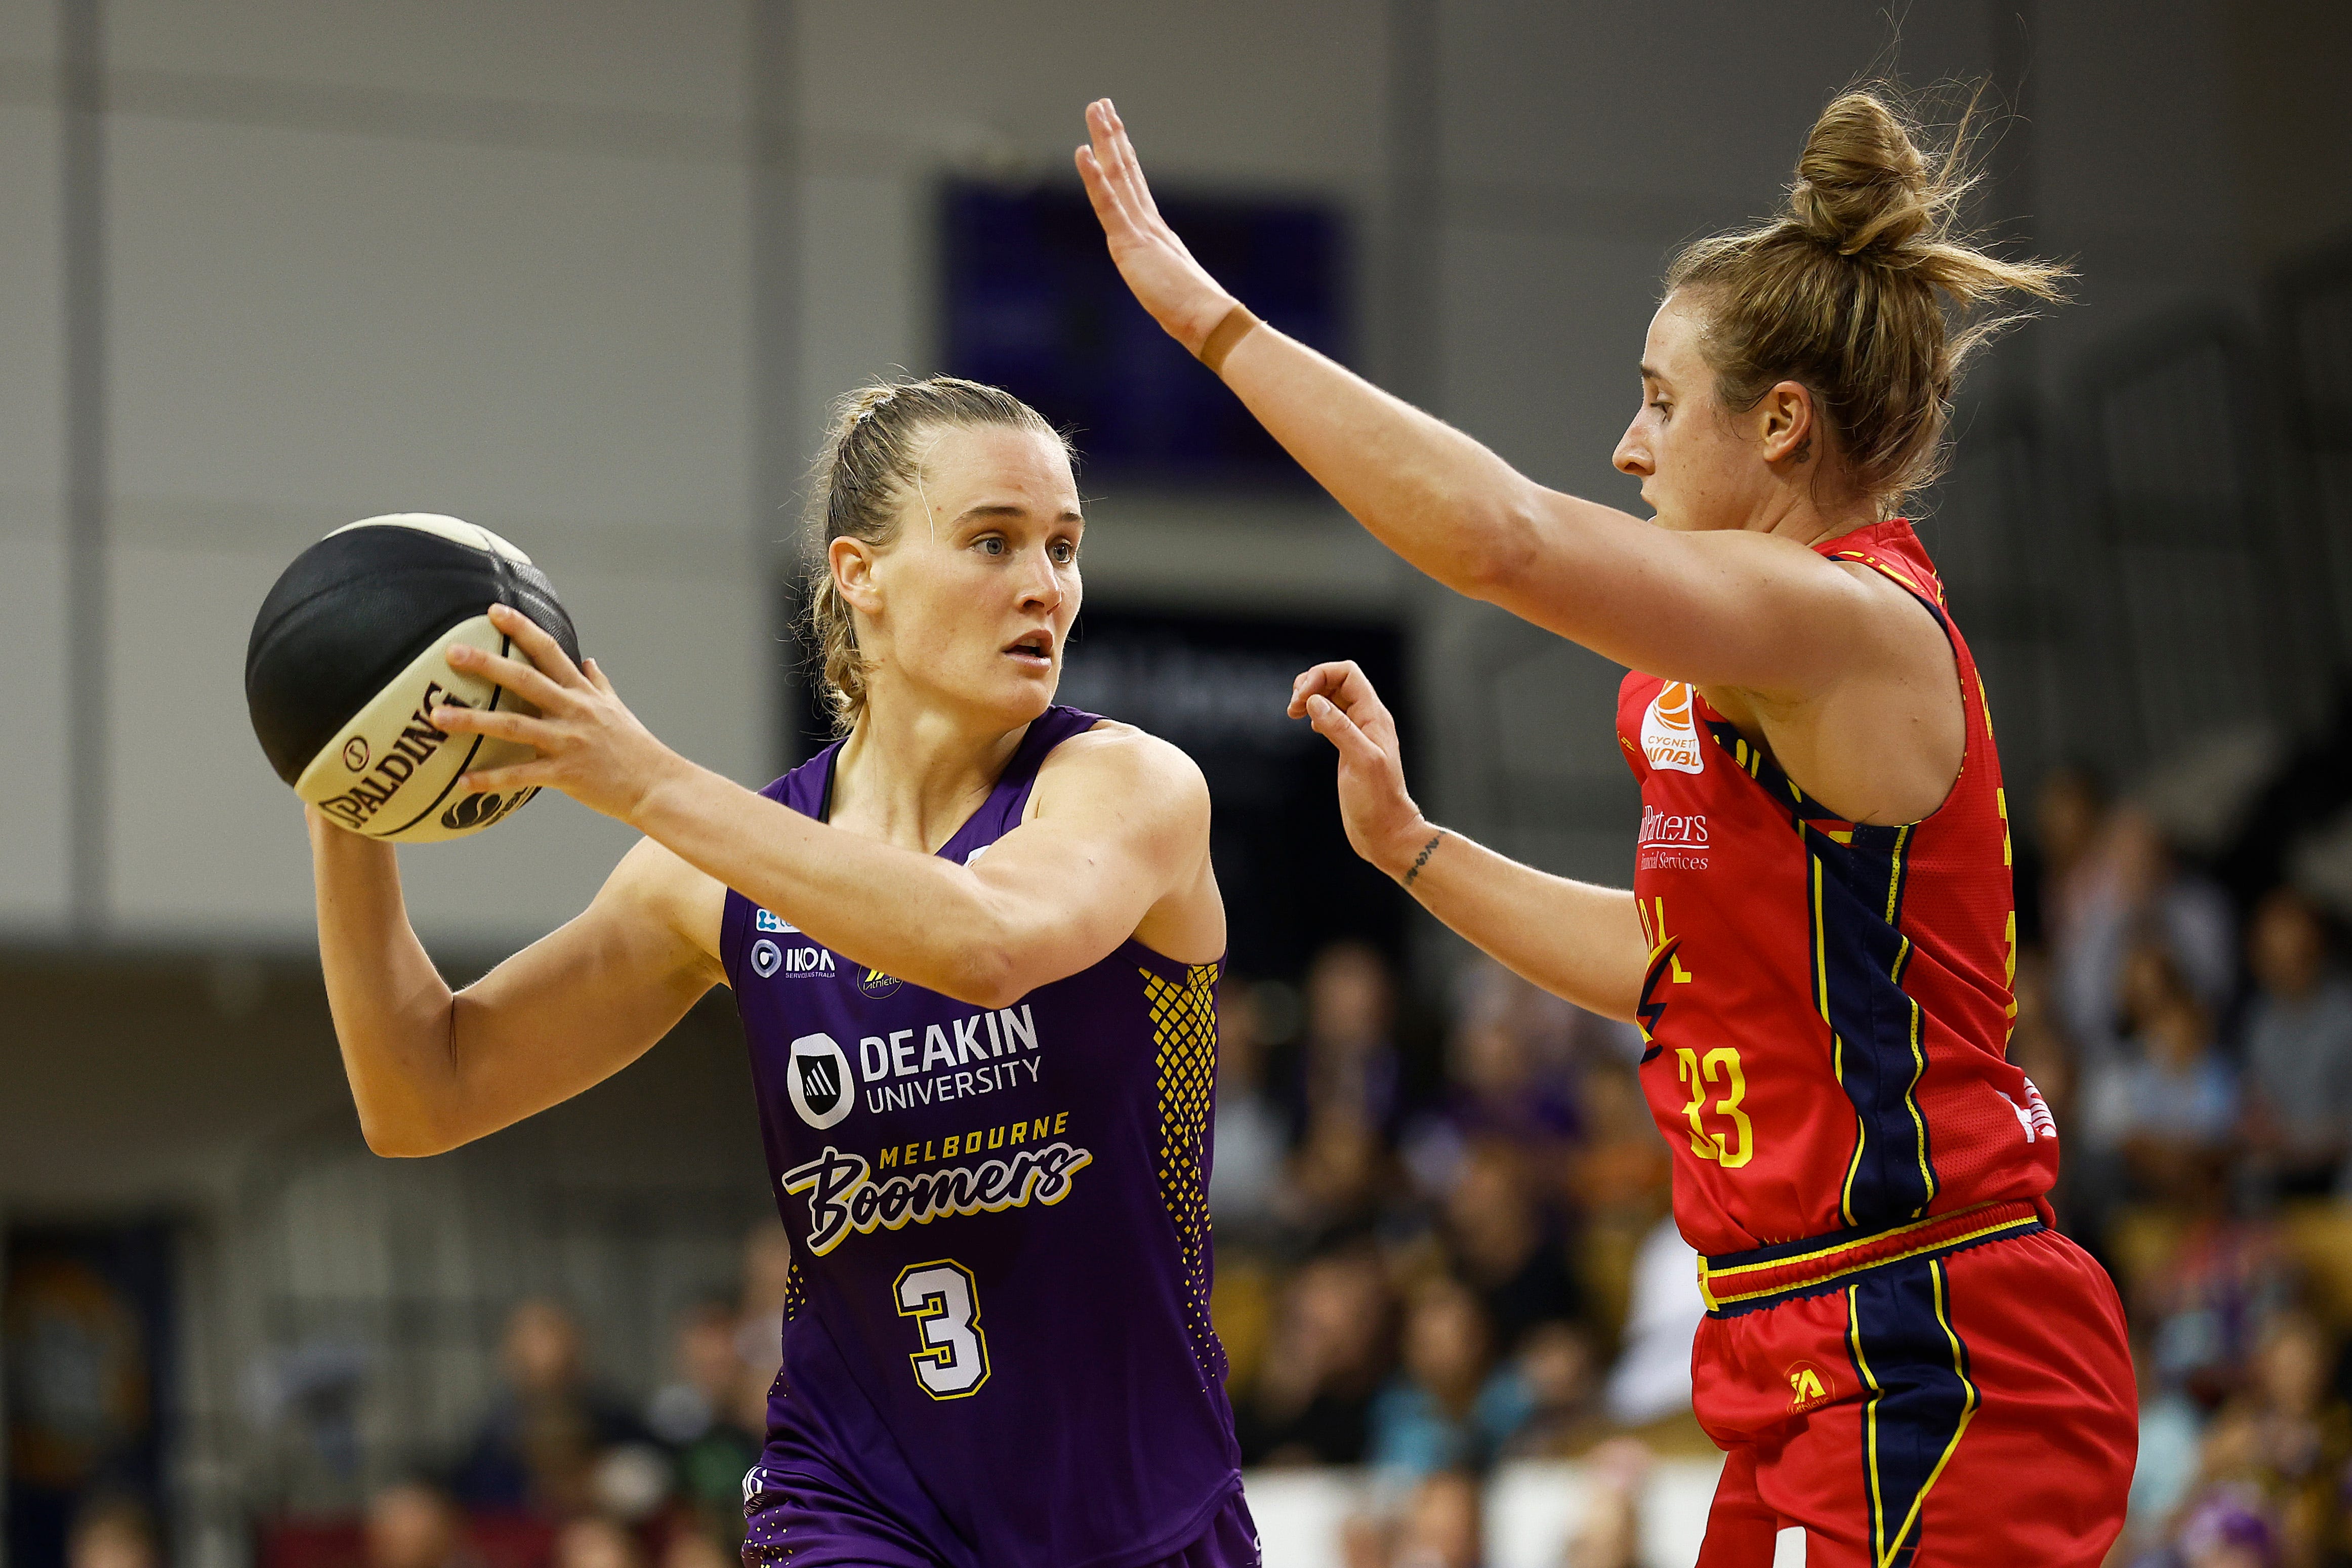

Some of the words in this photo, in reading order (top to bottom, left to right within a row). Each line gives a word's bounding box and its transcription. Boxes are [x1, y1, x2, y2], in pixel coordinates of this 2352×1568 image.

[319, 681, 471, 829] SPALDING
[1648, 735, 1697, 749] CYGNETT
[1659, 852, 1709, 870] Services
[786, 947, 835, 971] IKON
[860, 1004, 1039, 1083] DEAKIN
[866, 1055, 1041, 1113] UNIVERSITY
[1674, 1047, 1753, 1169] 33
[880, 1111, 1069, 1170] MELBOURNE
[782, 1146, 1092, 1256] Boomers
[893, 1258, 991, 1401] 3
